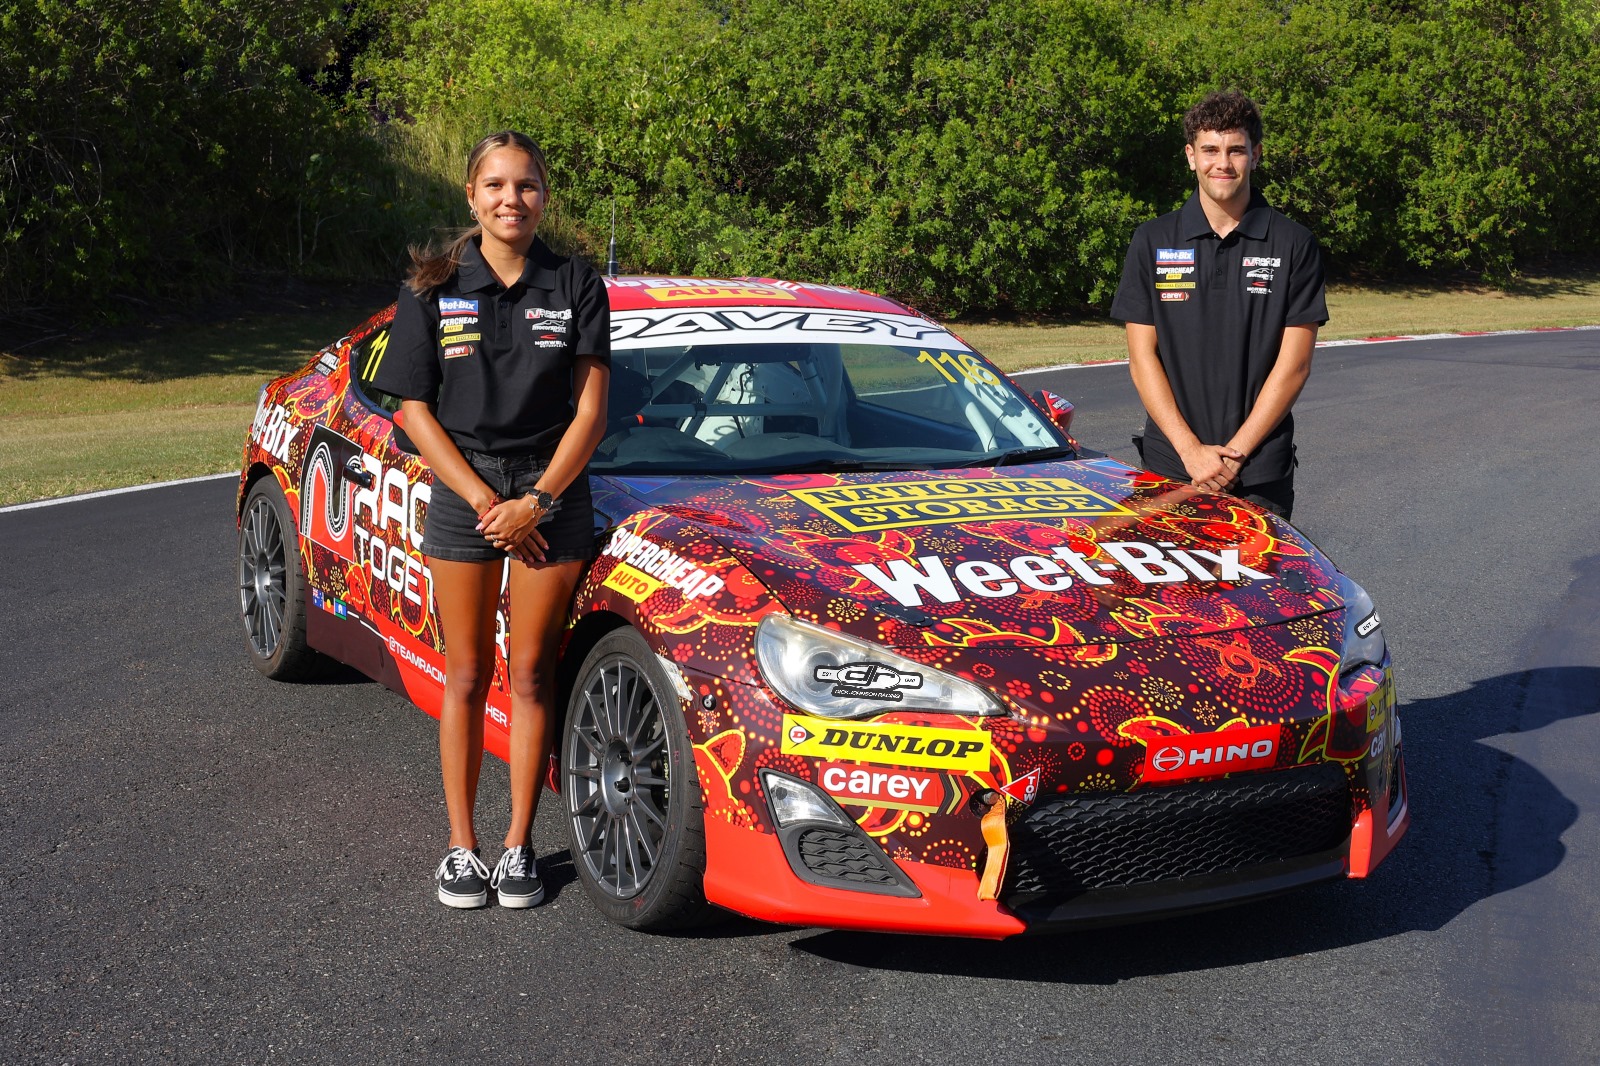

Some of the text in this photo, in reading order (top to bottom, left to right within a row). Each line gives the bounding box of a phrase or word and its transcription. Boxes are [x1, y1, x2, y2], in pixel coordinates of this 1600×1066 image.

[1160, 251, 1192, 259] Weet-Bix
[1156, 267, 1195, 275] SUPERCHEAP
[440, 300, 475, 310] eet-Bix
[667, 288, 776, 297] AUTO
[440, 317, 478, 329] PERCHEAP
[362, 331, 390, 382] 11
[445, 347, 465, 356] arey
[916, 350, 1001, 386] 116
[354, 453, 432, 551] RAC
[803, 478, 1080, 504] NATIONAL
[852, 496, 1106, 523] STORAGE
[355, 524, 434, 614] TOGET
[602, 527, 725, 601] SUPERCHEAP
[852, 541, 1274, 607] Weet-Bix
[610, 570, 649, 595] AUTO
[389, 635, 507, 728] @TEAMRACIN HER
[819, 728, 984, 759] DUNLOP
[1188, 739, 1273, 766] HINO
[823, 767, 931, 800] carey
[1023, 775, 1036, 802] TOW
